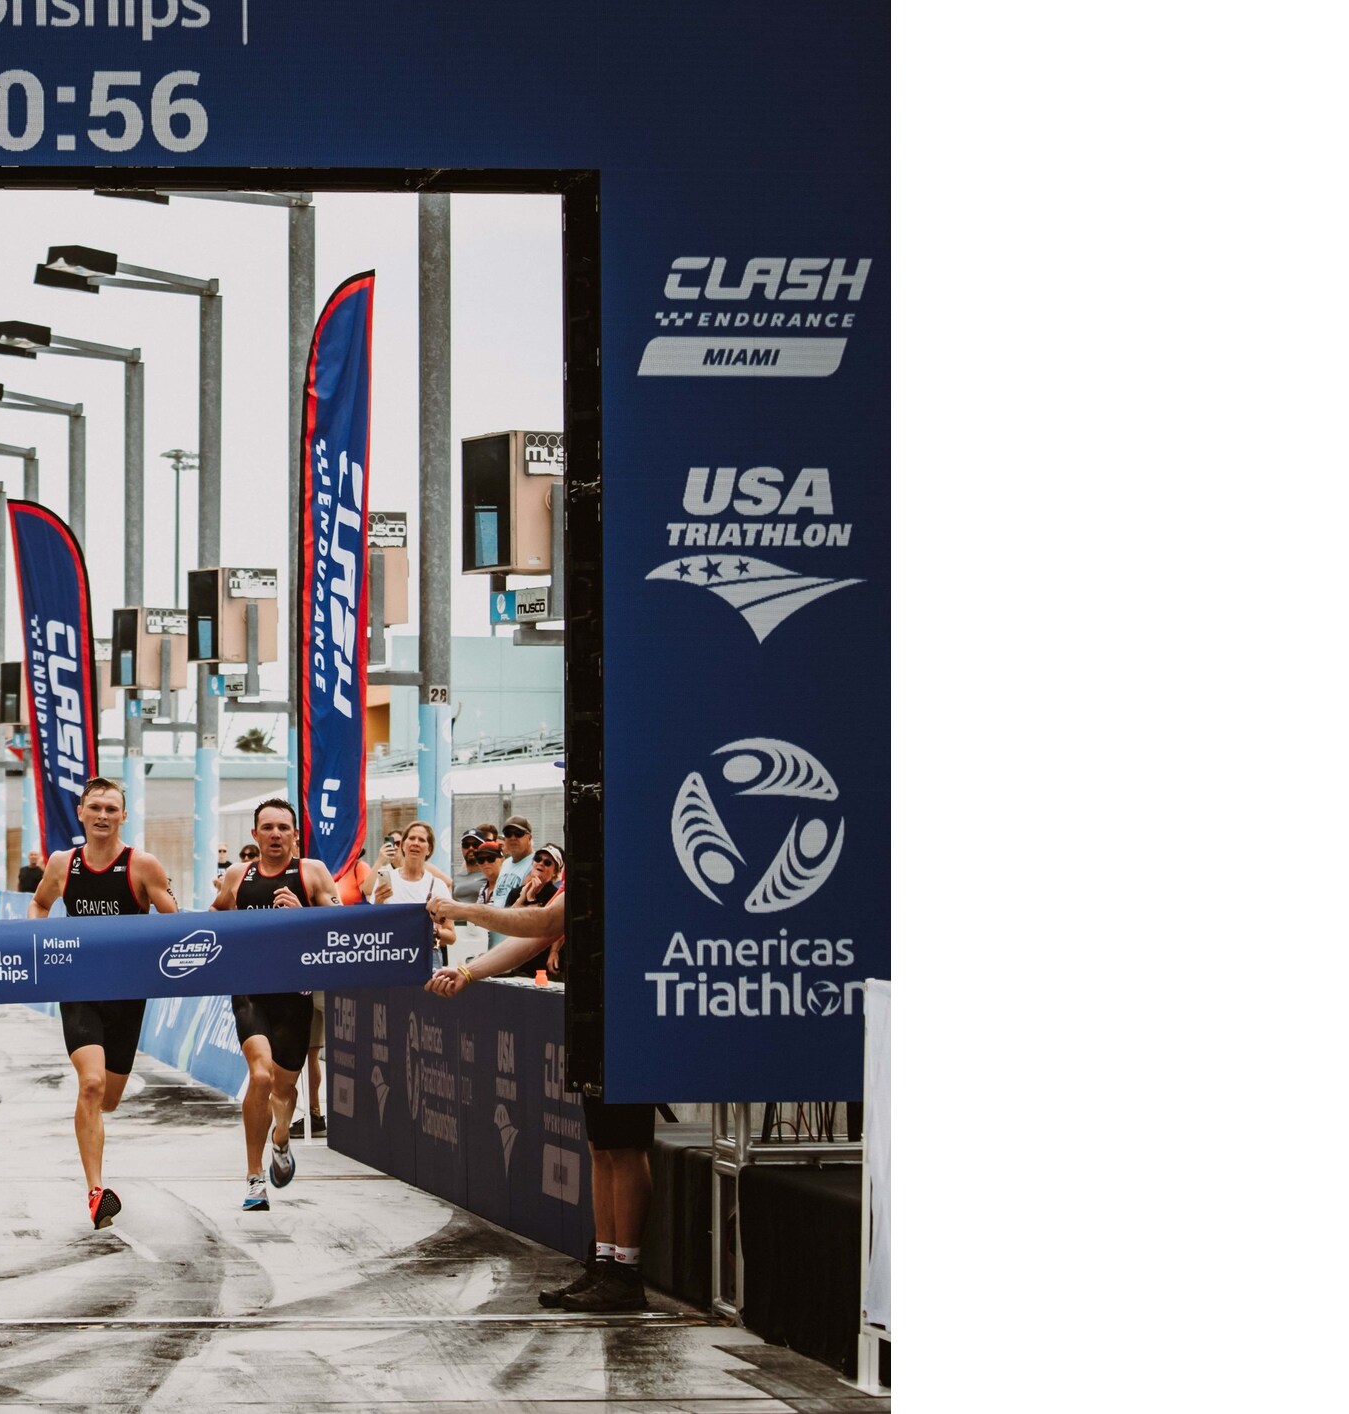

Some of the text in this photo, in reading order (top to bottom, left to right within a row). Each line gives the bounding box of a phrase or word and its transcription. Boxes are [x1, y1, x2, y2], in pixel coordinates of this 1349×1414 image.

[663, 256, 873, 301] CLASH
[697, 312, 856, 328] ENDURANCE
[702, 348, 781, 366] MIAMI
[682, 466, 834, 516] USA
[665, 522, 853, 548] TRIATHLON
[313, 490, 332, 694] ENDURANCE
[330, 450, 364, 719] CLASH
[46, 619, 85, 797] CLASH
[75, 898, 120, 916] CRAVENS
[42, 937, 80, 949] Miami
[171, 942, 212, 953] CLASH
[300, 946, 420, 965] extraordinary
[327, 930, 394, 949] Be your
[661, 928, 855, 967] Americas
[43, 953, 73, 965] 2024
[644, 971, 866, 1017] Triathlon
[497, 1030, 515, 1075] USA
[544, 1042, 581, 1106] CLA
